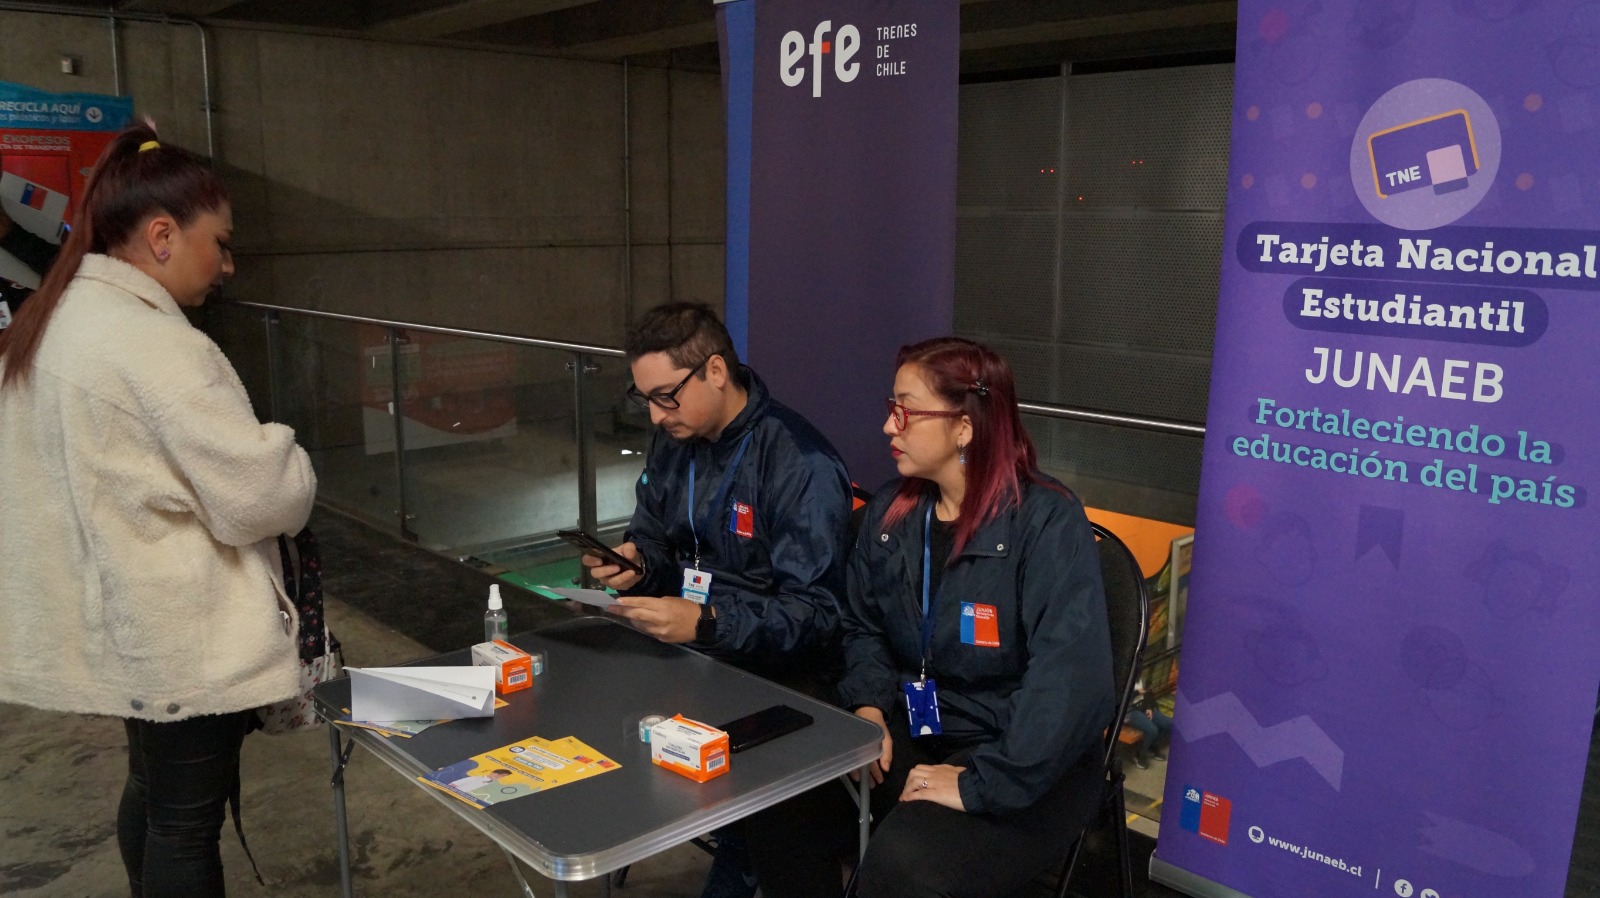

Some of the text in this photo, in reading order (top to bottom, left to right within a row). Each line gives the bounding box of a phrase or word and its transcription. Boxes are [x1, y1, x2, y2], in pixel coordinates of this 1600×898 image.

[877, 23, 917, 40] TRENES
[877, 45, 889, 58] DE
[780, 20, 860, 97] efe
[876, 61, 906, 76] CHILE
[1385, 166, 1422, 187] TNE
[1256, 234, 1597, 278] Tarjeta Nacional
[1300, 288, 1525, 333] Estudiantil
[1305, 347, 1504, 403] JUNAEB
[1255, 398, 1552, 464] Fortaleciendo la
[1232, 434, 1576, 508] educación del país
[1268, 835, 1362, 877] www.junaeb.cl
